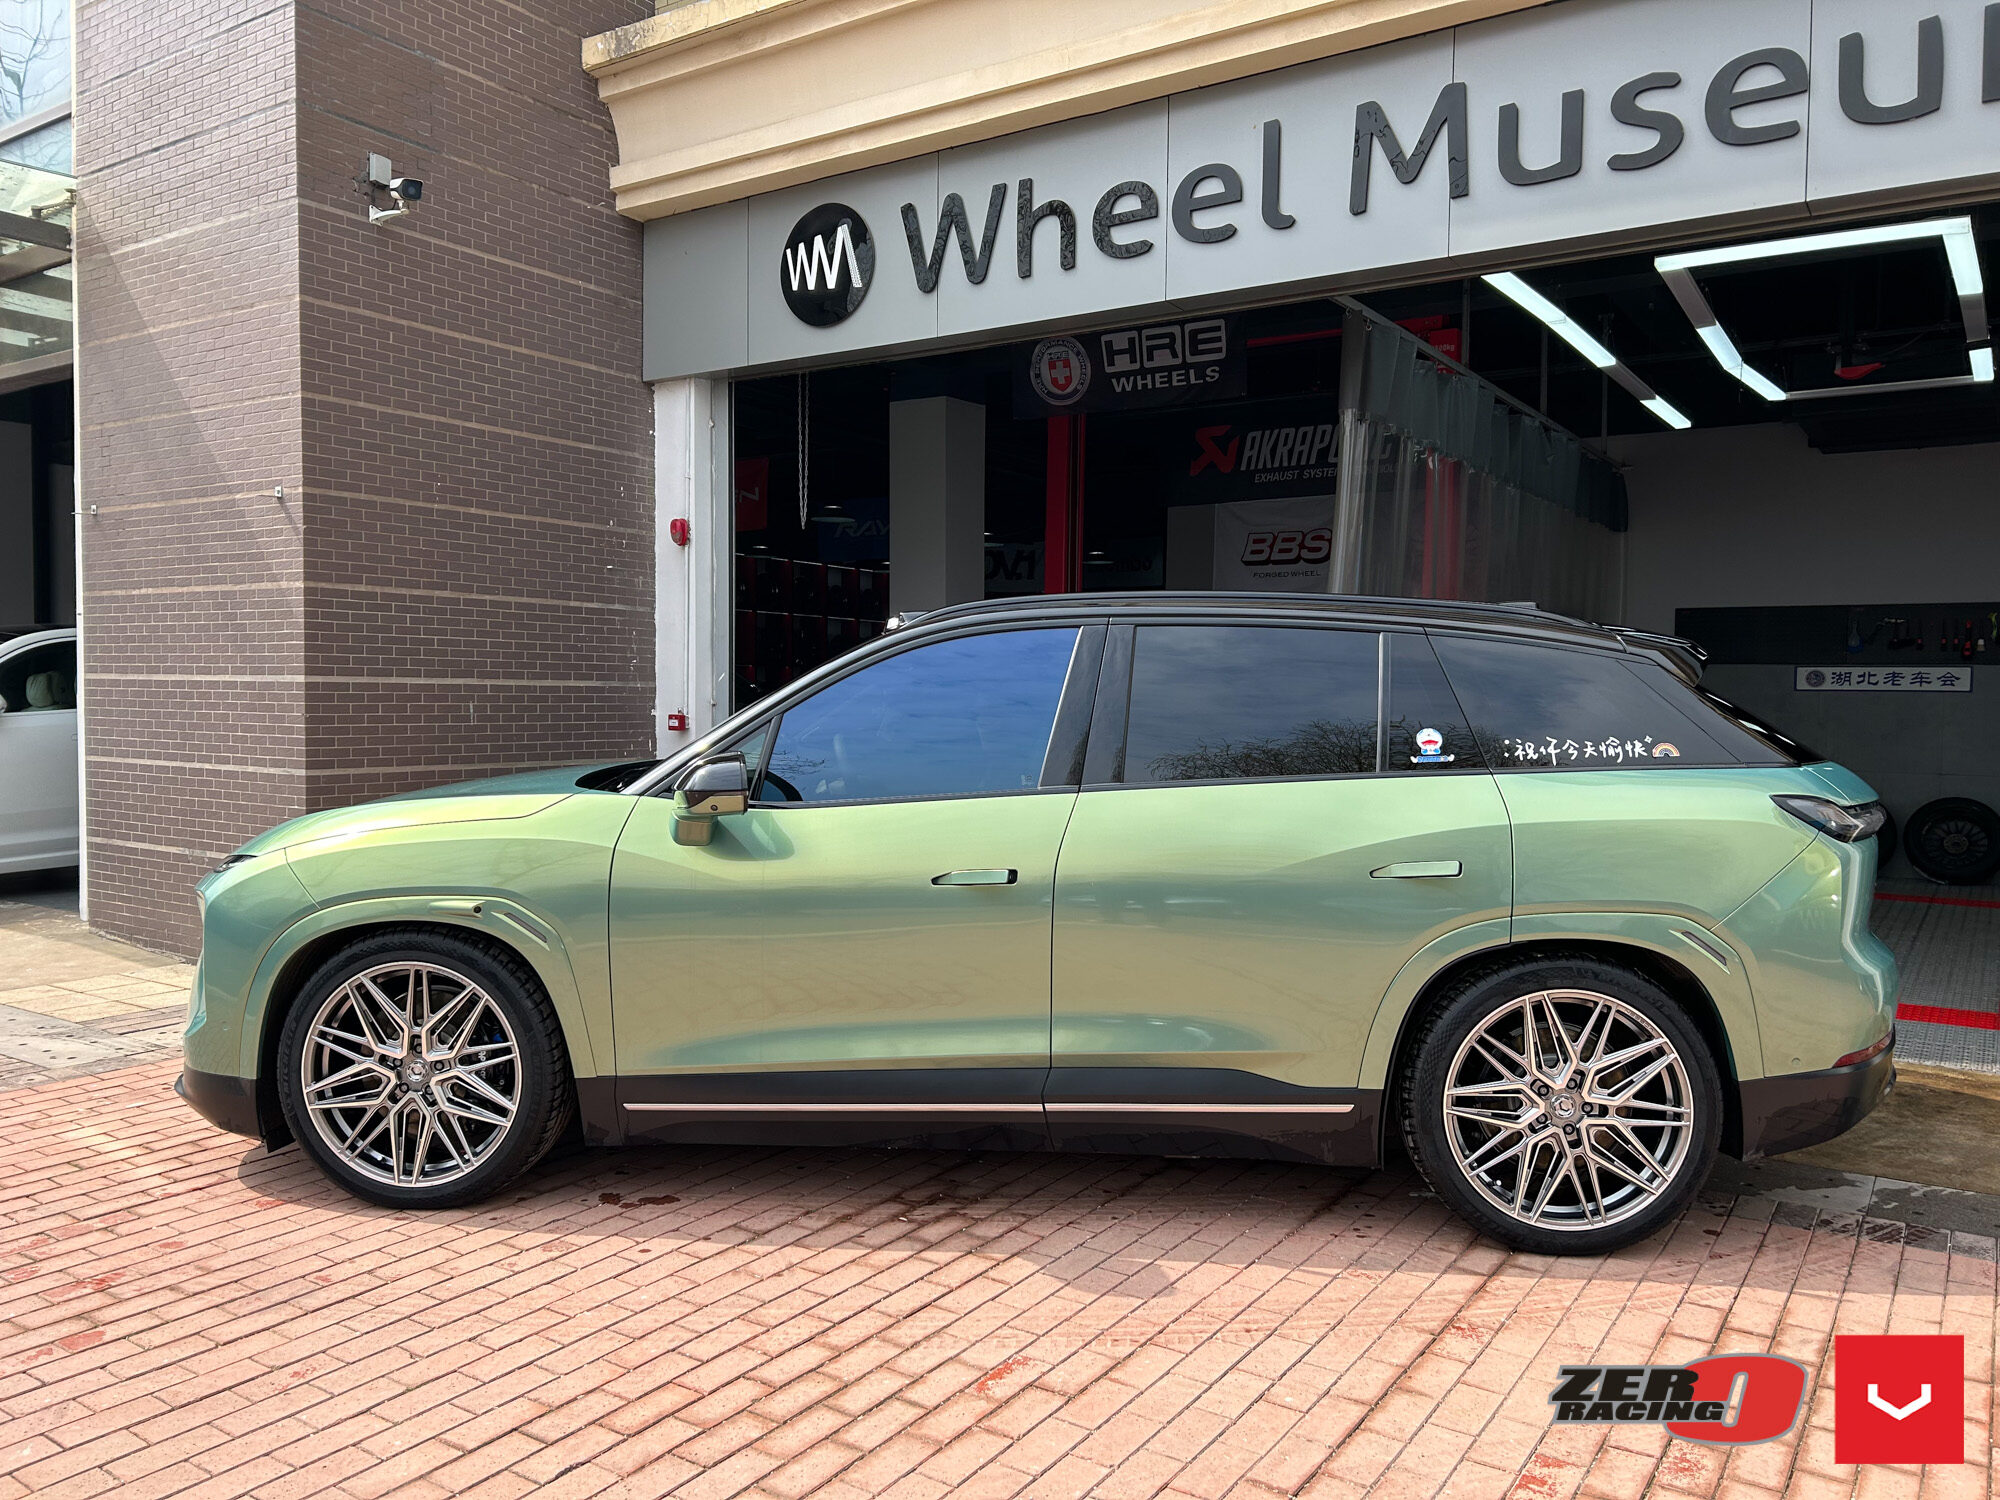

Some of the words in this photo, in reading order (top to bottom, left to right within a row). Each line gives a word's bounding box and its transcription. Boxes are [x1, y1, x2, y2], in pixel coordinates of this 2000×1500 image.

[900, 118, 1296, 293] Wheel
[1349, 2, 2000, 215] Museu
[1101, 318, 1227, 374] HRE
[1111, 366, 1220, 393] WHEELS
[1254, 471, 1299, 483] EXHAUST
[1241, 528, 1333, 566] BBS
[1830, 671, 1961, 687] 湖北老车会
